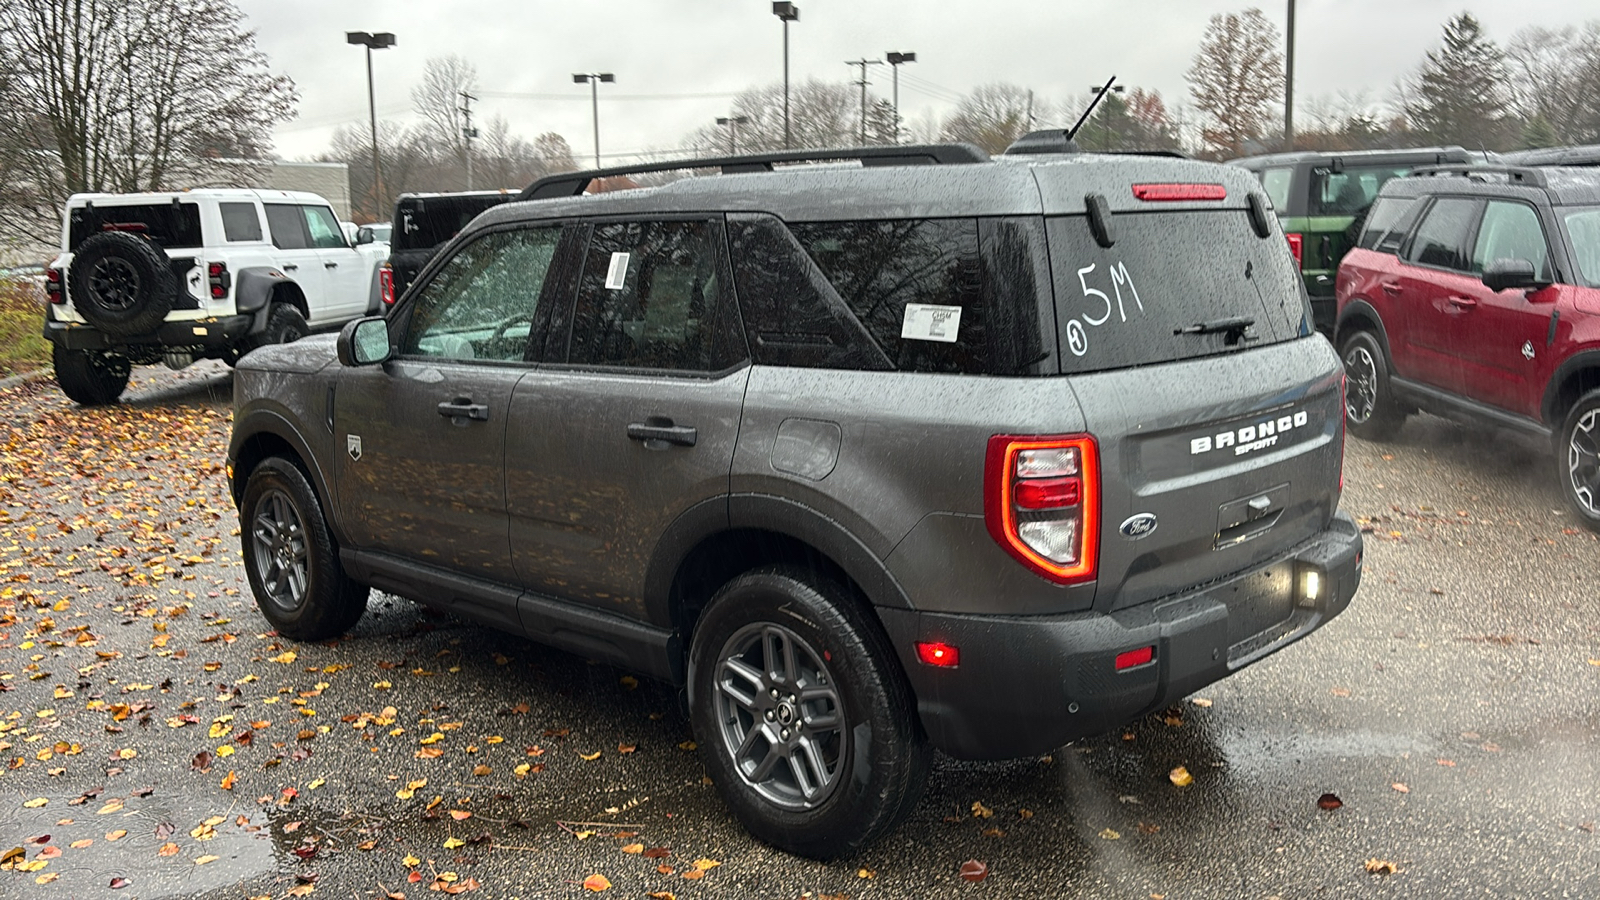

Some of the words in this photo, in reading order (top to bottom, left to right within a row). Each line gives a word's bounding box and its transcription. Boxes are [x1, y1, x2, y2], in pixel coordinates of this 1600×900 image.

[1077, 260, 1144, 326] 5M
[1190, 410, 1308, 455] BRONCO
[1235, 435, 1278, 456] SPORT
[1130, 518, 1152, 536] Ford
